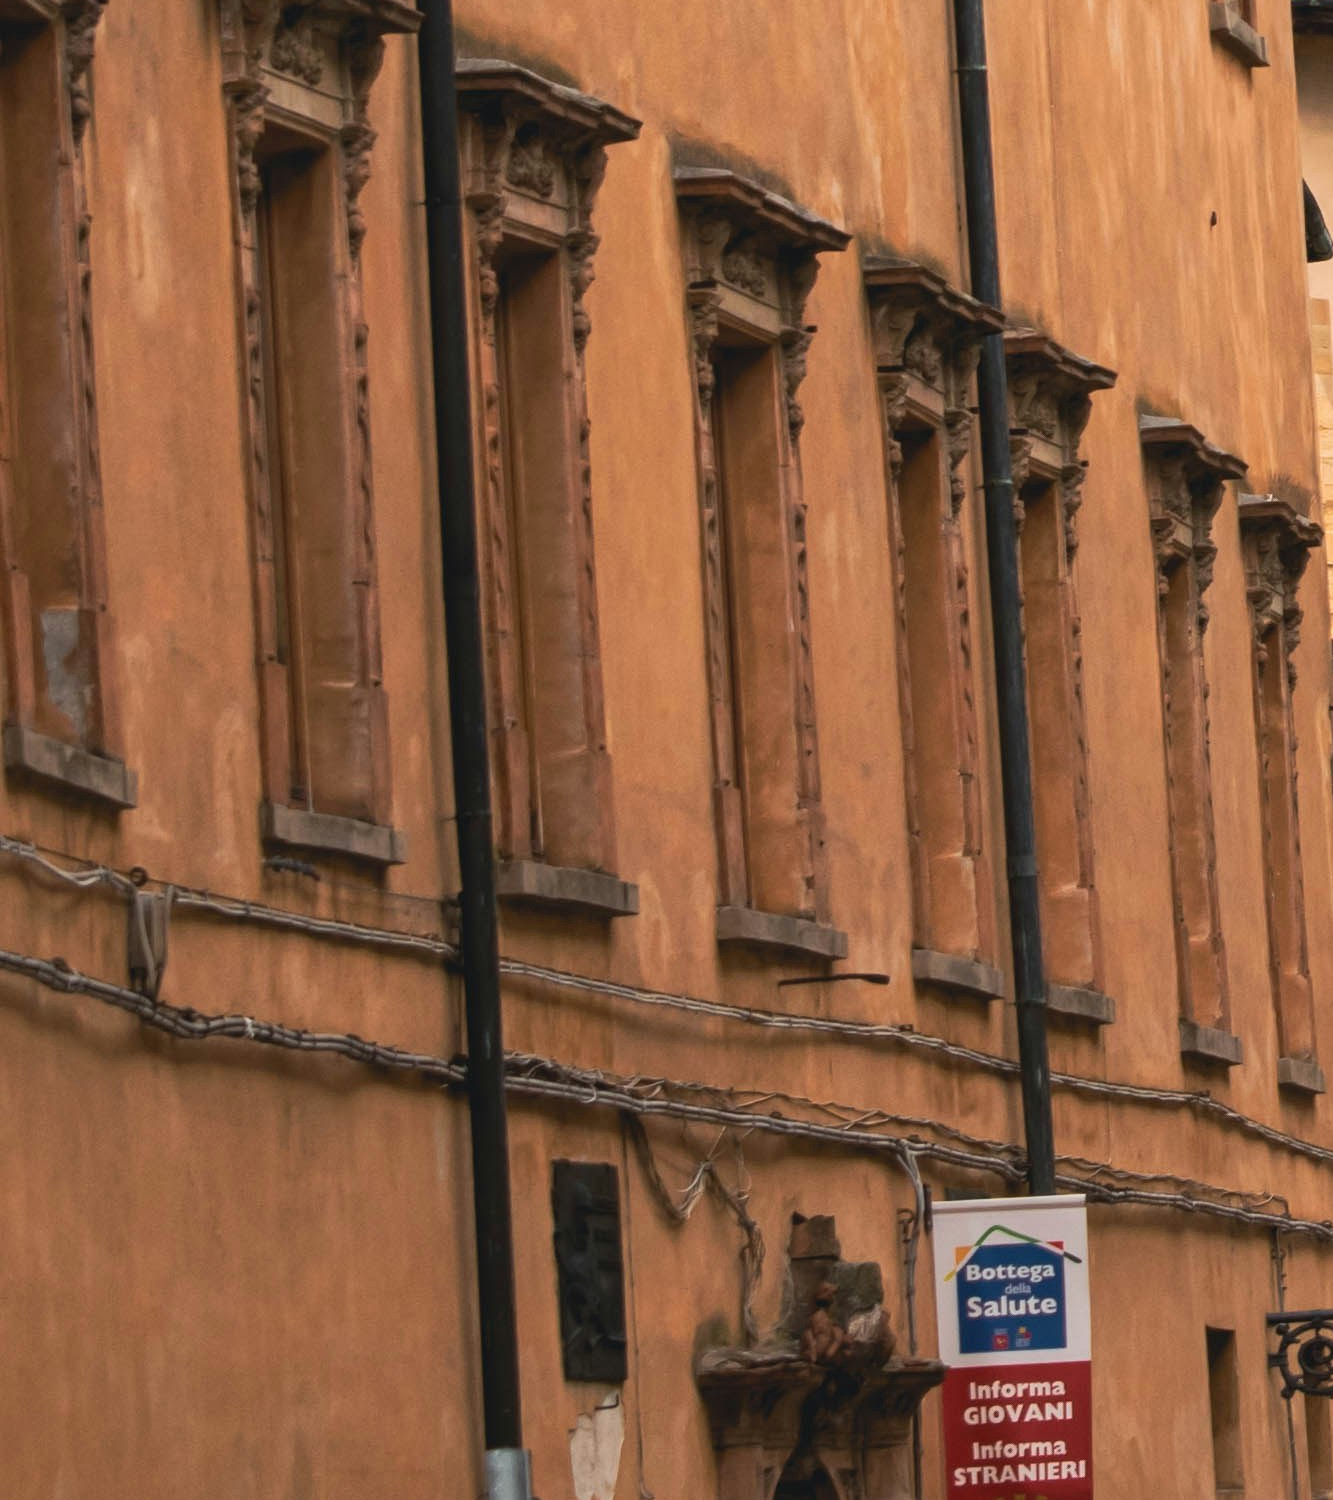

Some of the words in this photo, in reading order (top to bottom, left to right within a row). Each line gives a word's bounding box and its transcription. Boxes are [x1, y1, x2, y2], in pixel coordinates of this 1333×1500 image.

[966, 1264, 1056, 1283] Bottega
[1004, 1282, 1032, 1294] della
[967, 1295, 1058, 1318] Salute
[970, 1380, 1066, 1400] Informa
[964, 1401, 1073, 1425] GIOVANI
[972, 1440, 1067, 1460] Informa
[954, 1460, 1087, 1486] STRANIERI
